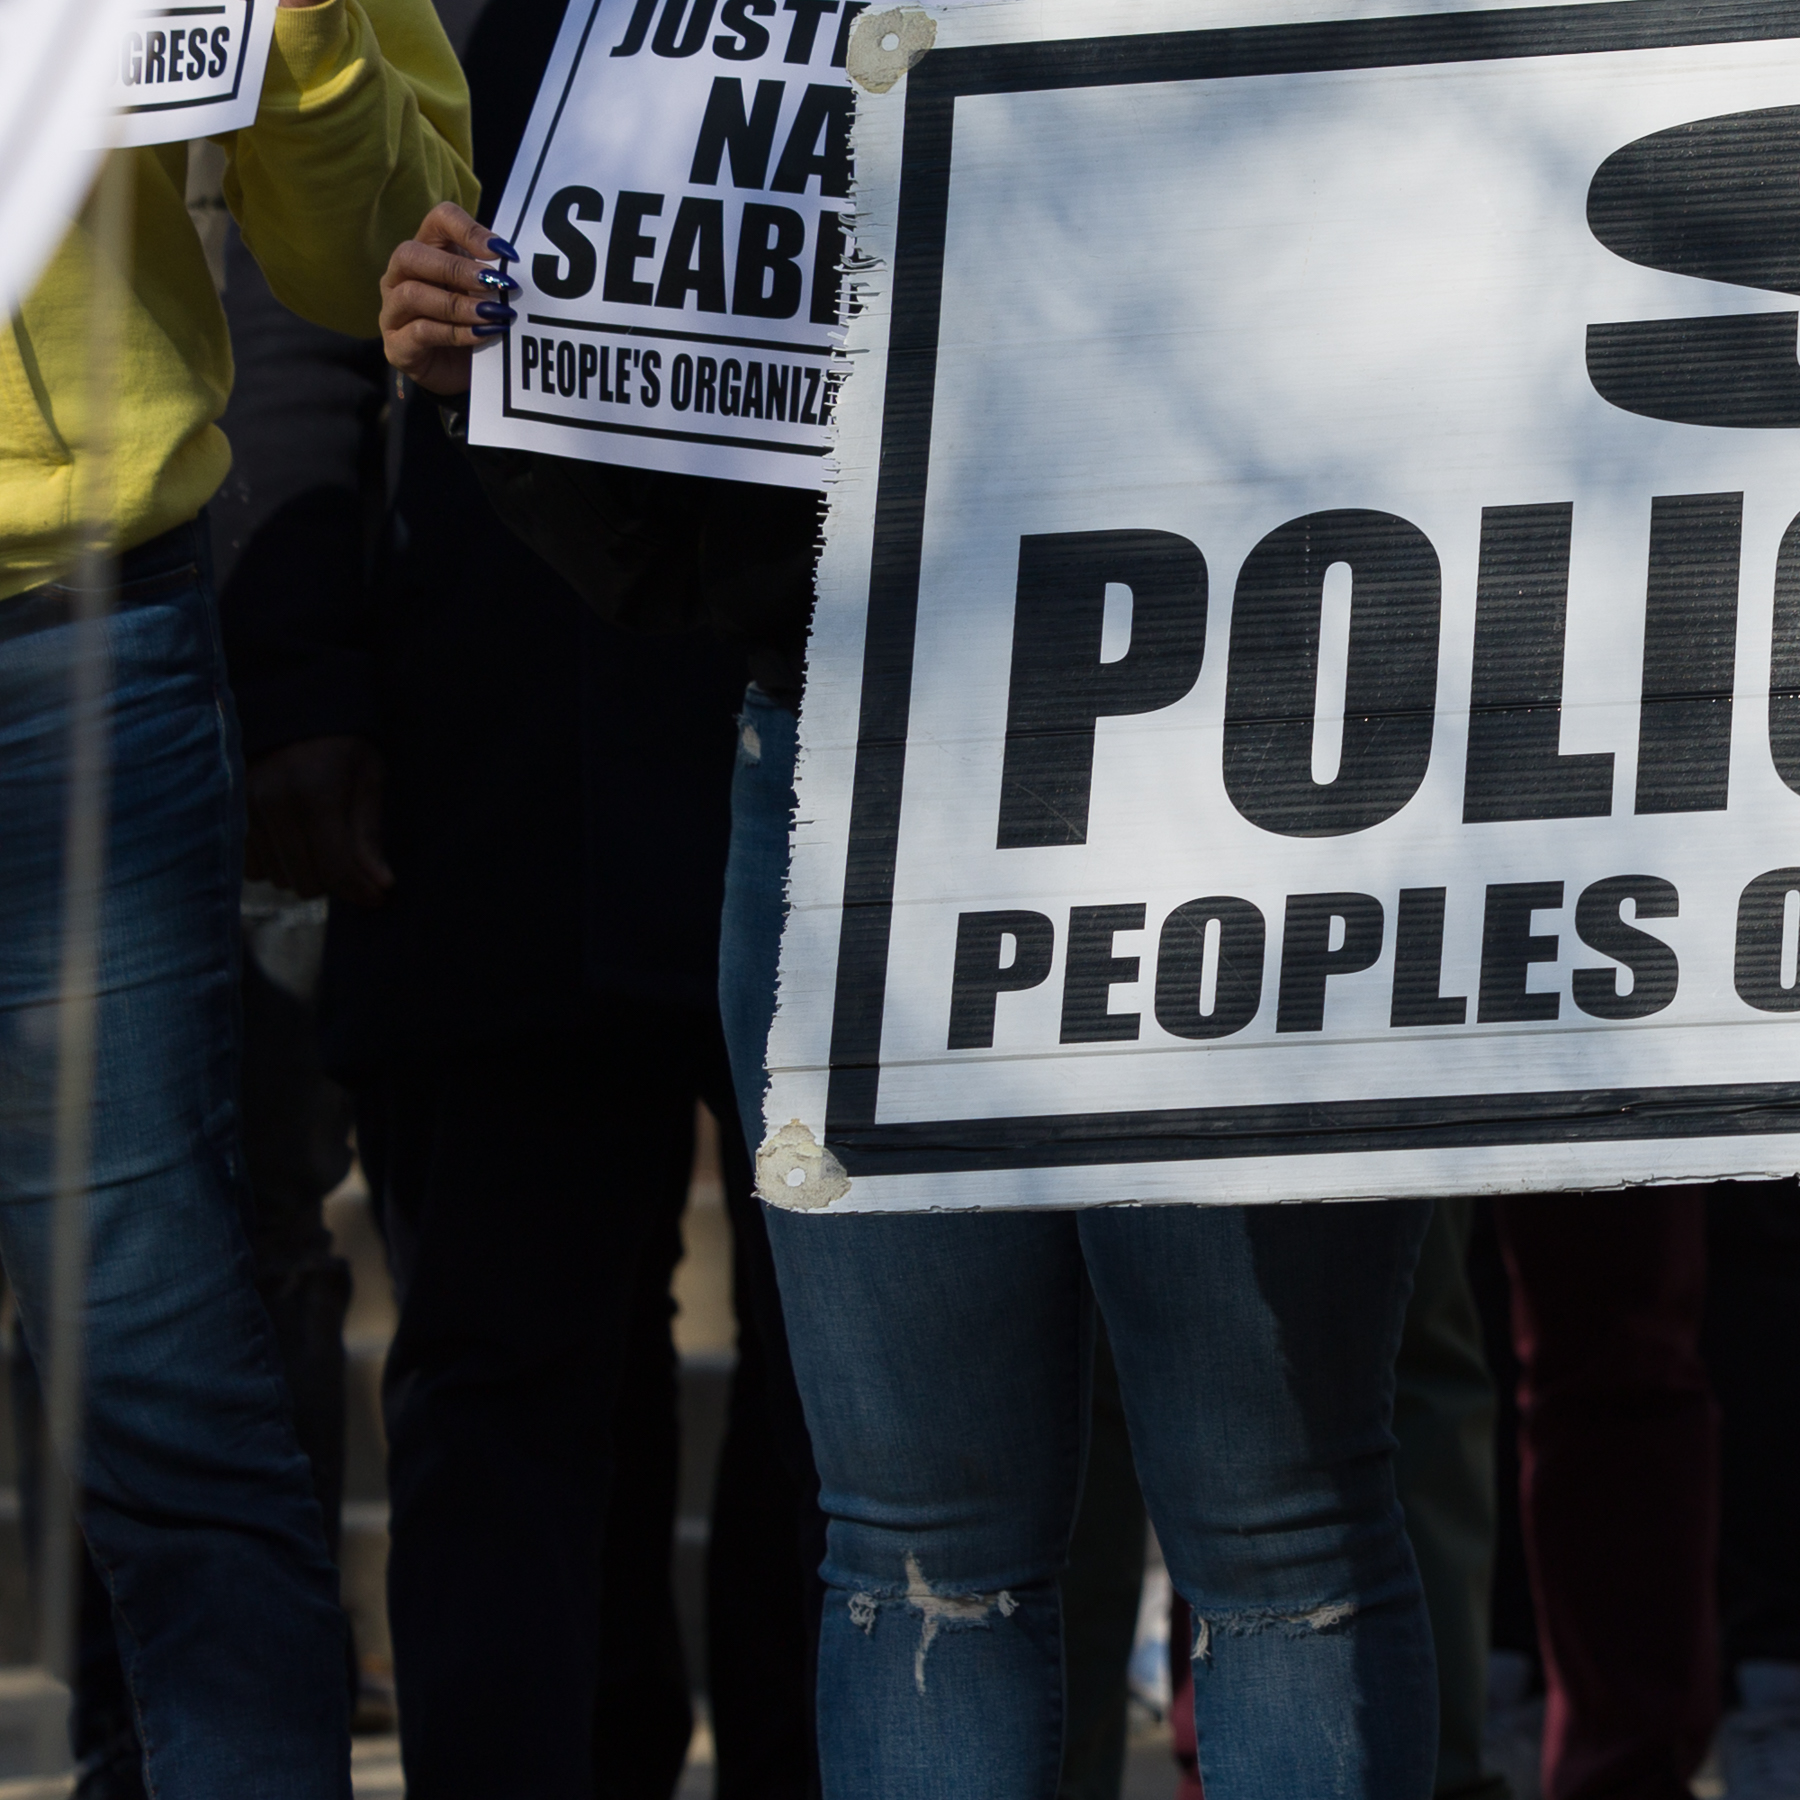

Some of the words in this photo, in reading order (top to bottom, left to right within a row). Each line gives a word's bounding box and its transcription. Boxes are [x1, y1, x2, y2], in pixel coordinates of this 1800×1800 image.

[114, 26, 230, 88] GRESS
[688, 76, 858, 199] NA
[521, 334, 662, 408] PEOPLE'S
[948, 874, 1679, 1050] PEOPLES
